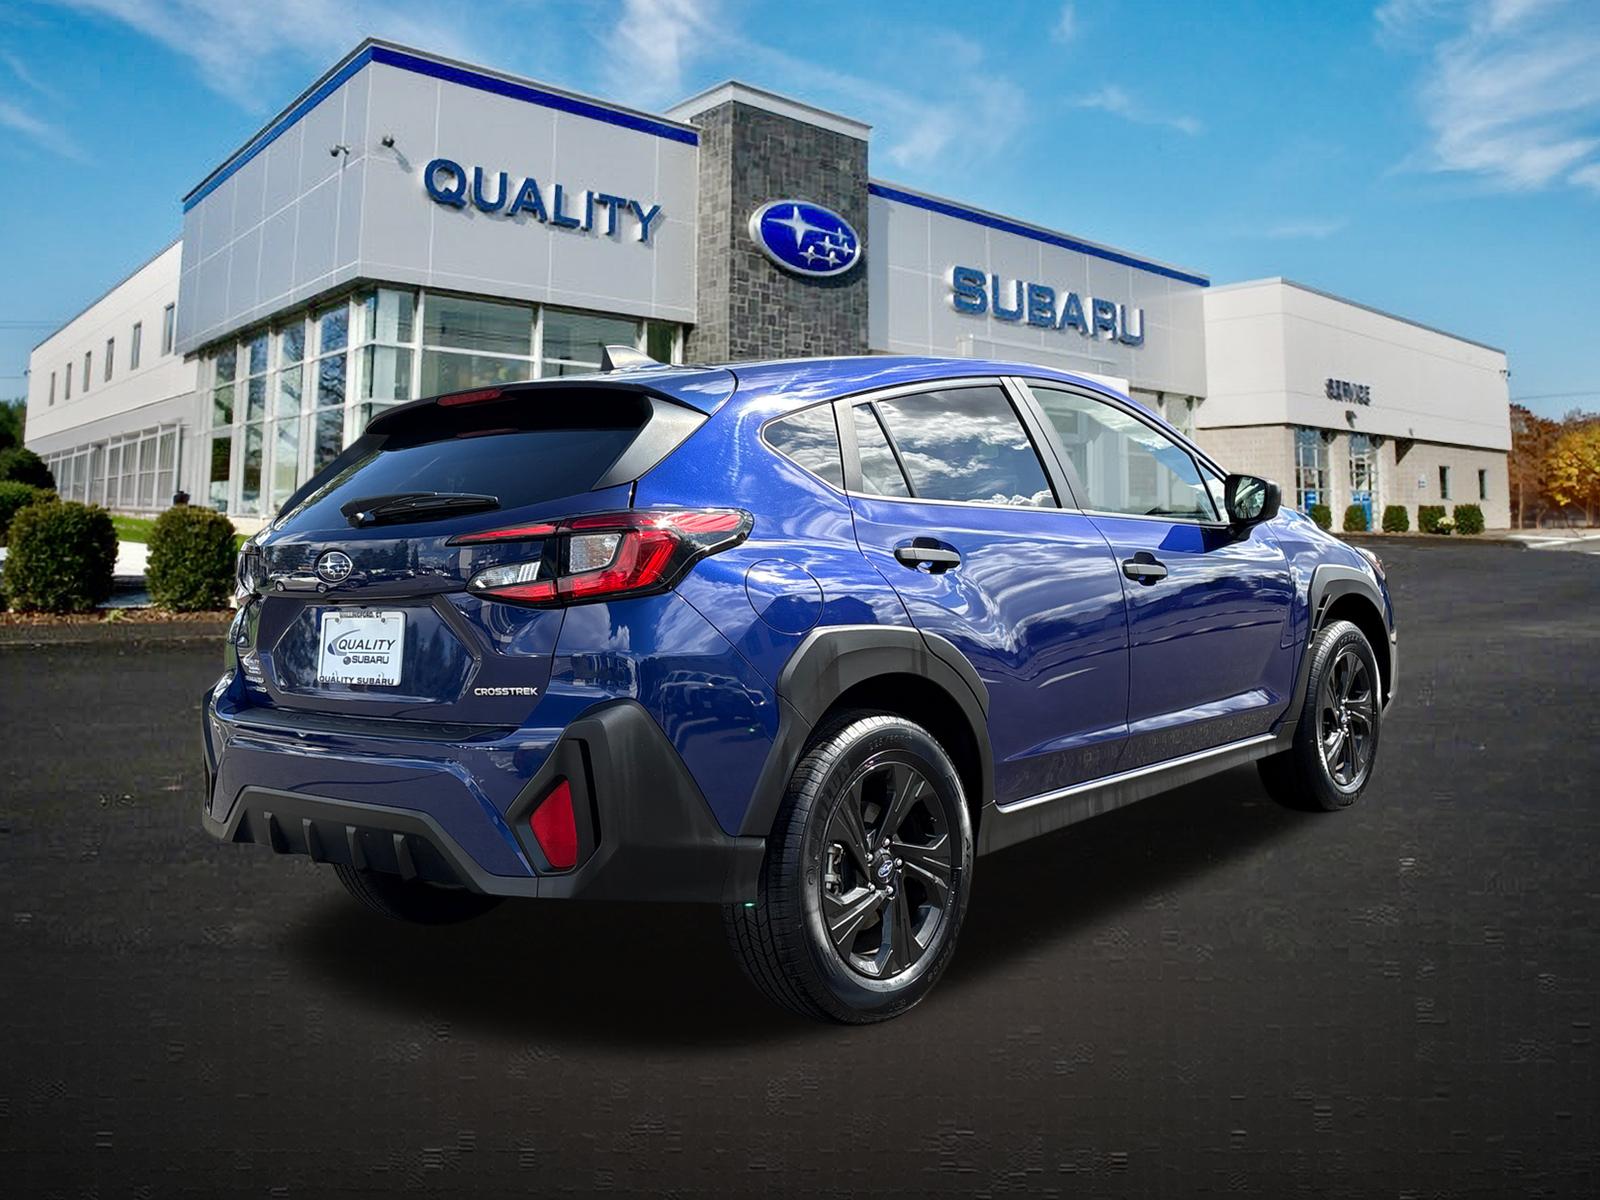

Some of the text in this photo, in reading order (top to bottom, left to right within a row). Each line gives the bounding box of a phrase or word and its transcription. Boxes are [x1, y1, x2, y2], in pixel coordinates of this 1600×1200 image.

[424, 158, 661, 242] QUALITY
[951, 265, 1145, 346] SUBARU
[338, 639, 396, 651] QUALITY
[351, 655, 390, 665] SUBARU
[319, 675, 395, 686] QUALITY SUBARU
[474, 687, 539, 696] CROSSTREK
